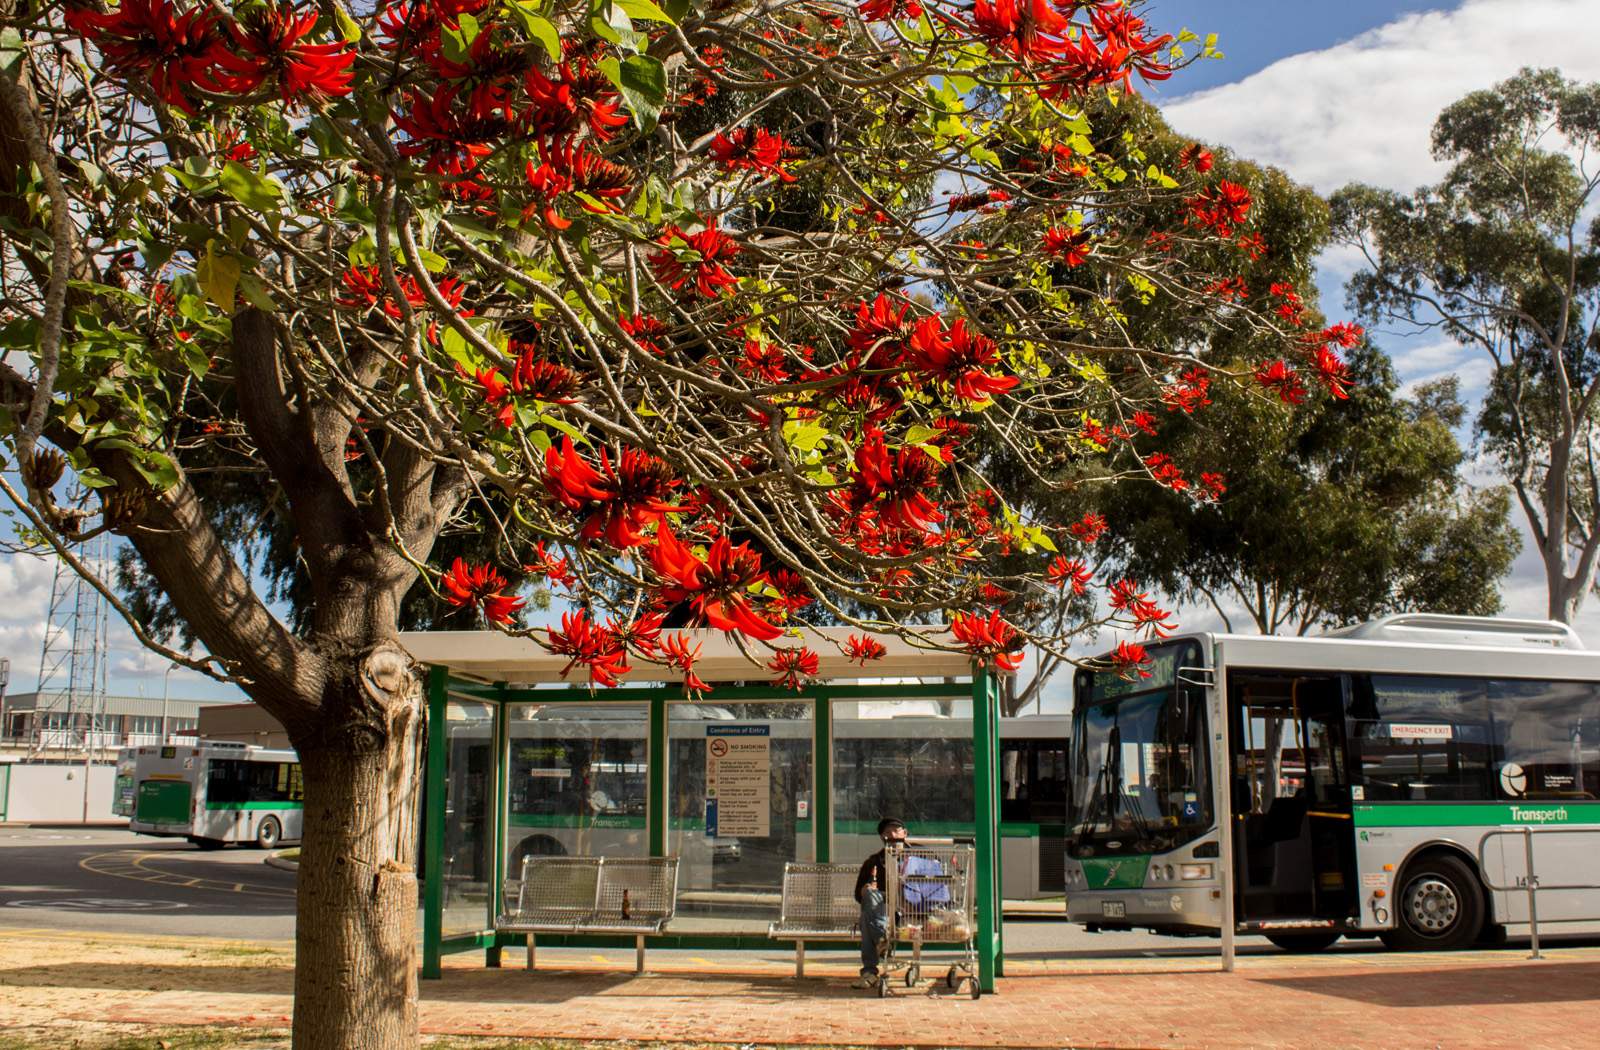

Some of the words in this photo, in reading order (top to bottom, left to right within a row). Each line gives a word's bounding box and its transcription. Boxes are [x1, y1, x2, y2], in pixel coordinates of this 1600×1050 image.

[749, 727, 766, 735] Entry
[1391, 726, 1432, 734] EMERGENCY
[1509, 806, 1568, 824] Transperth
